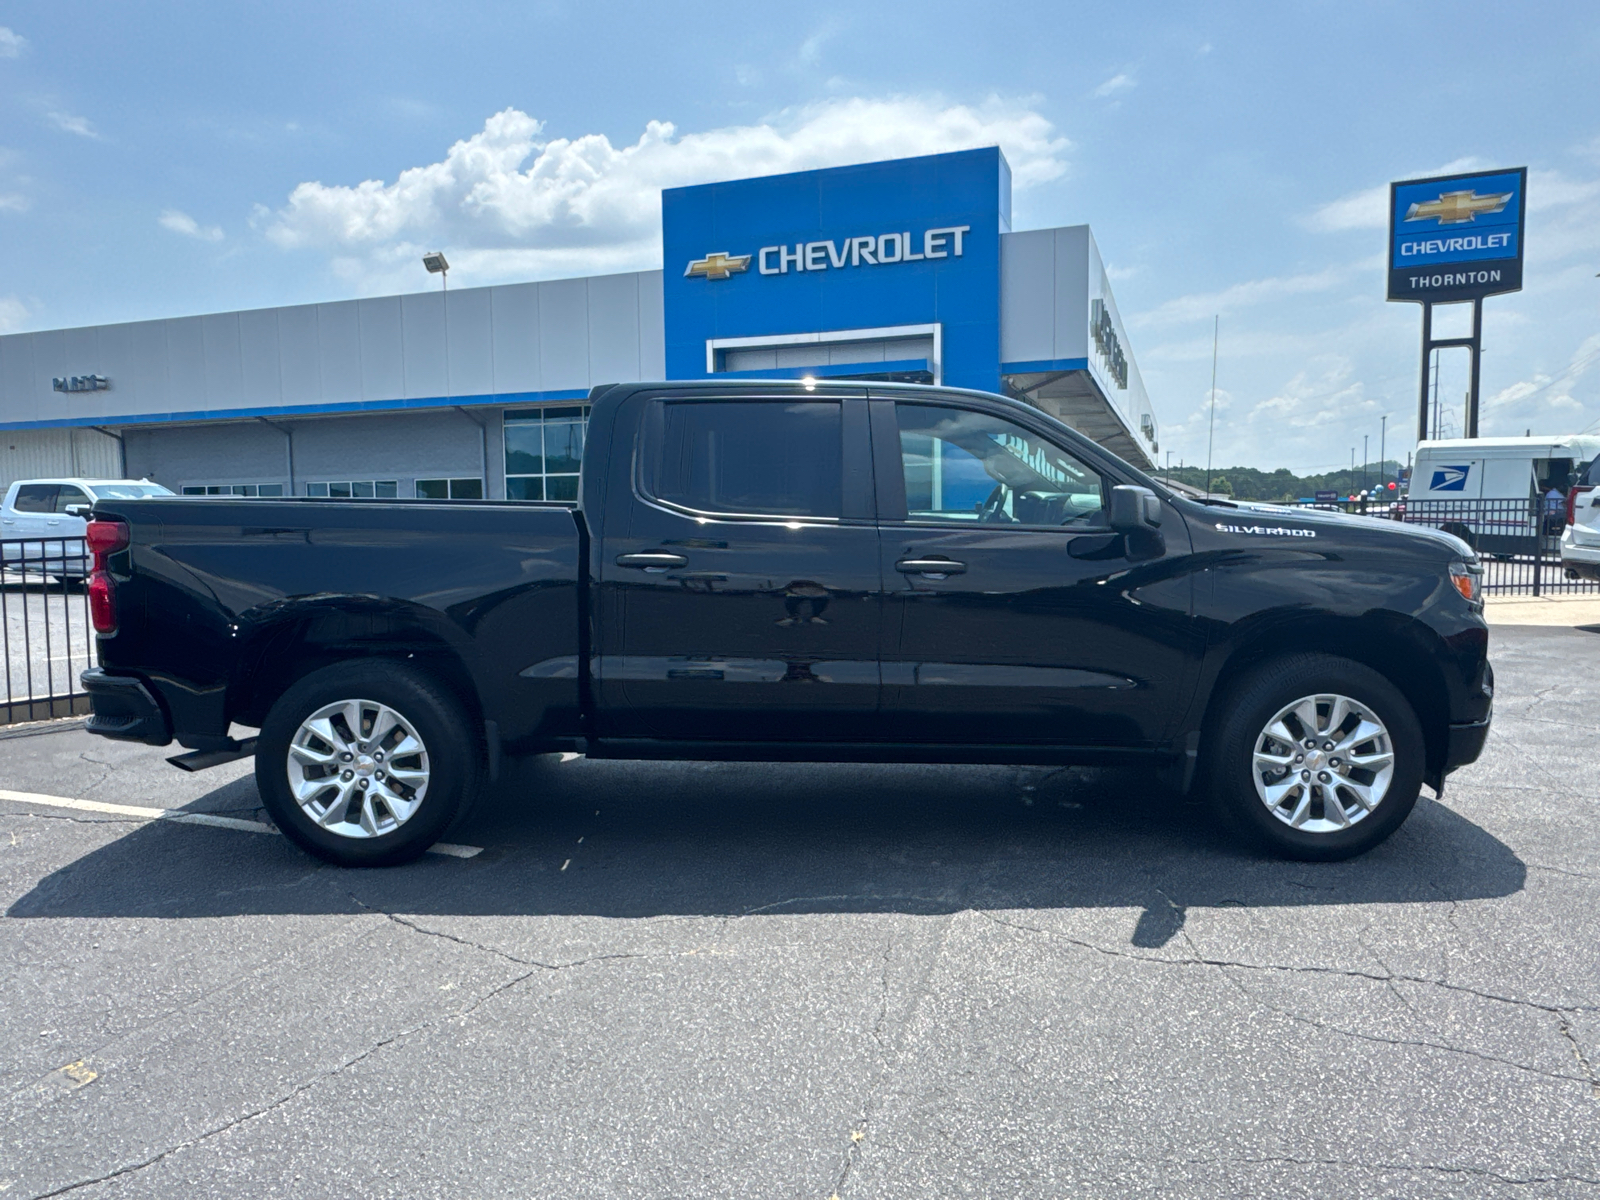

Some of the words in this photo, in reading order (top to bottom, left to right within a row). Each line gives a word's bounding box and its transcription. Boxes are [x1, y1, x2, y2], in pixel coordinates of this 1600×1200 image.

[758, 225, 970, 275] CHEVROLET
[1401, 233, 1511, 256] CHEVROLET
[1409, 269, 1501, 288] THORNTON
[52, 374, 102, 392] PARTS
[1215, 523, 1316, 538] SILVERADO
